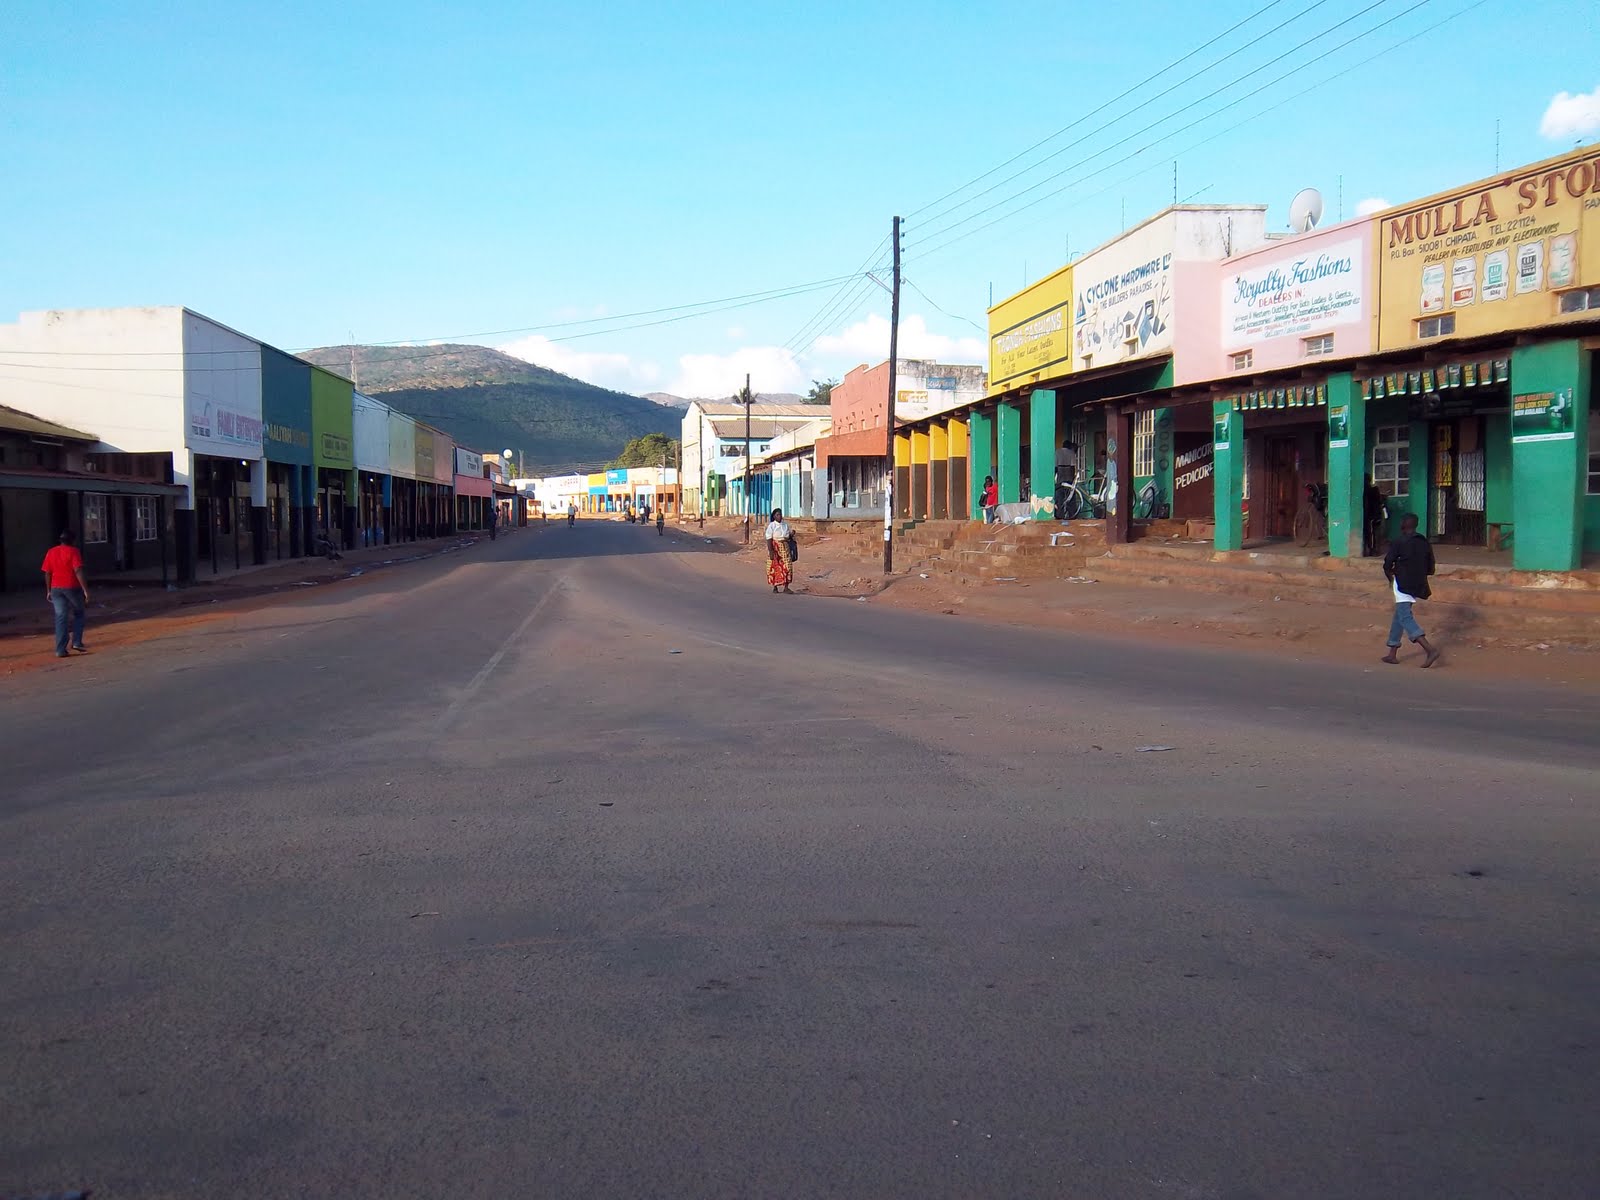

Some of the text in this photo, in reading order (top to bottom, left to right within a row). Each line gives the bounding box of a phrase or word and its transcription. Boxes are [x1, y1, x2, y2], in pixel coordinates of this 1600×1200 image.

[1389, 192, 1498, 248] MULLA
[1402, 247, 1415, 258] Box
[1424, 250, 1450, 263] DEALERS
[1495, 235, 1511, 246] AND
[1086, 274, 1119, 304] CYCLONE
[1120, 257, 1161, 289] HARDWARE
[1129, 279, 1153, 298] PARADISE
[1234, 254, 1352, 307] Royalty Fashions
[1258, 290, 1293, 308] DEALERS
[1311, 296, 1327, 306] Ladies
[1175, 442, 1214, 470] MANICUR
